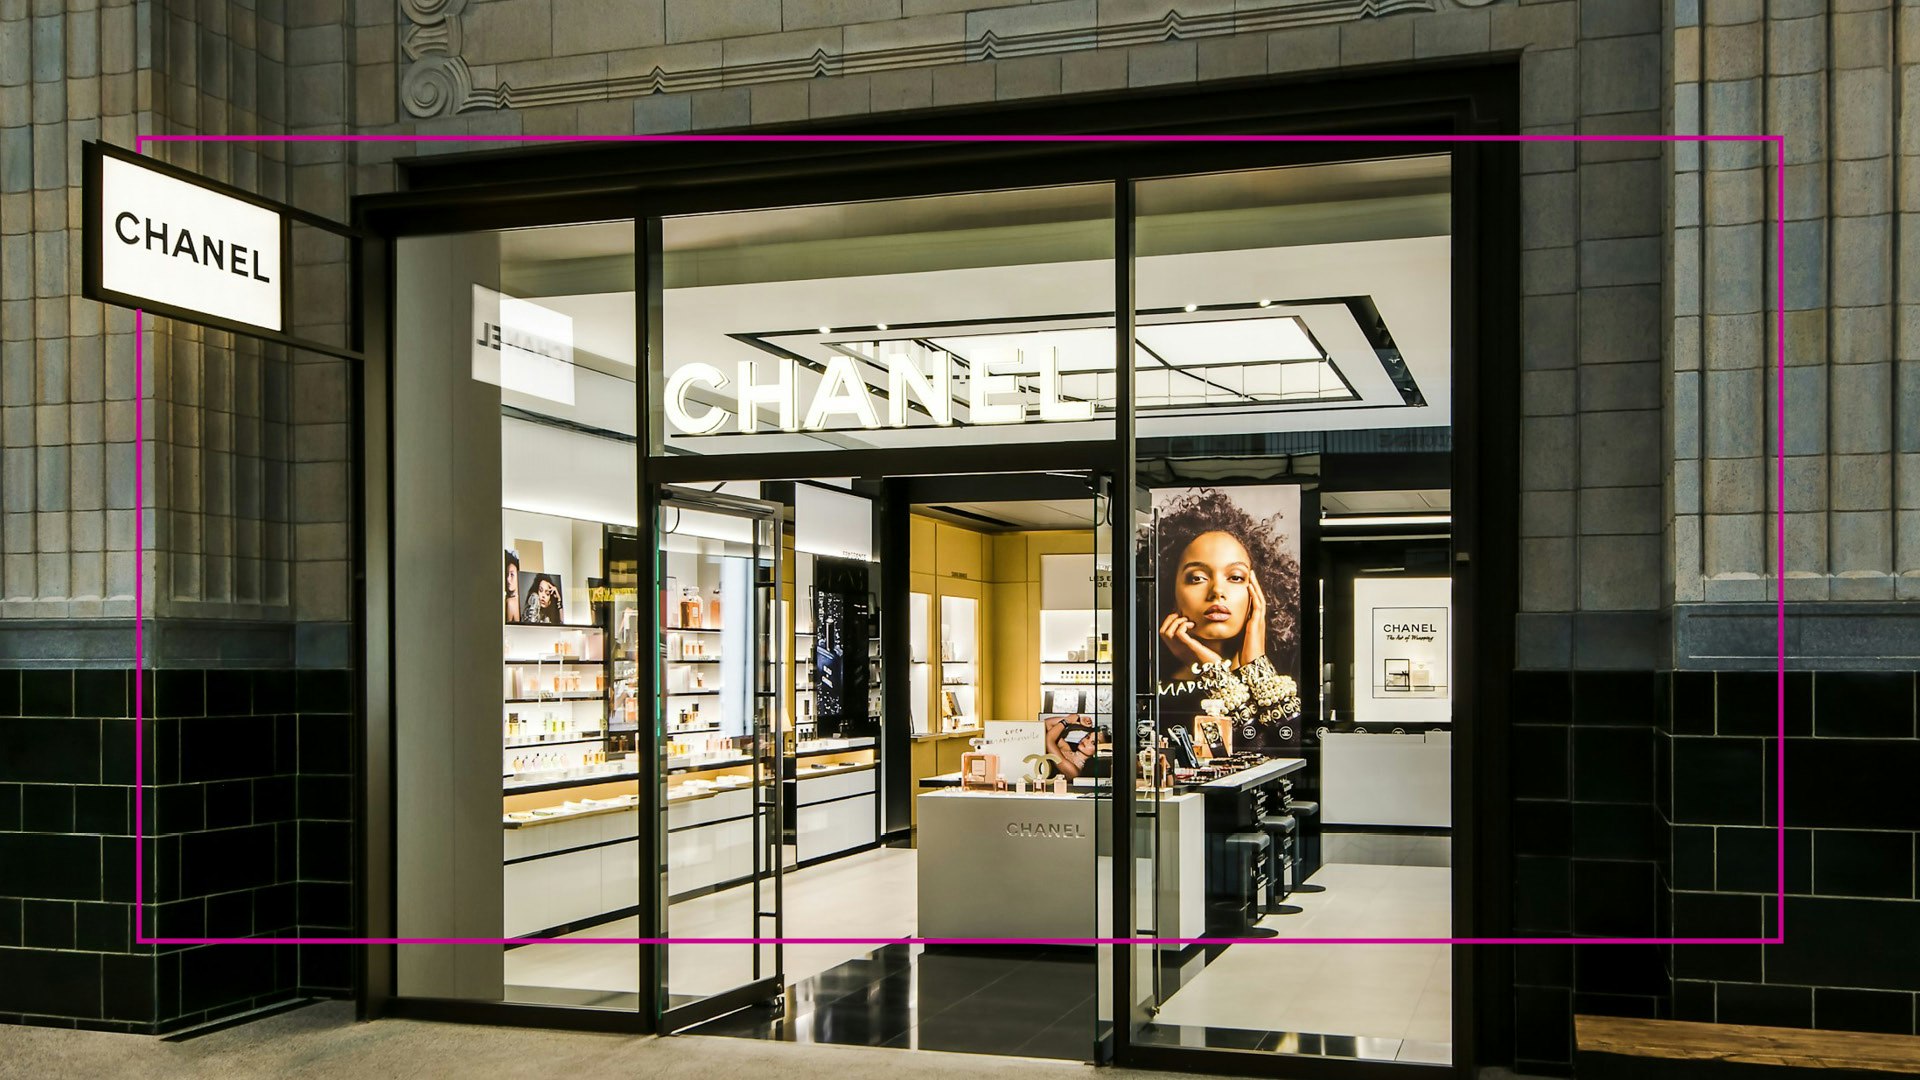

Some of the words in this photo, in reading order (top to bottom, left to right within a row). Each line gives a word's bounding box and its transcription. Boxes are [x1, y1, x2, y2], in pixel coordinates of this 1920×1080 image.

[114, 210, 271, 284] CHANEL
[663, 345, 1095, 436] CHANEL
[1383, 623, 1437, 633] CHANEL
[1404, 634, 1411, 643] of
[1006, 822, 1086, 838] CHANEL
